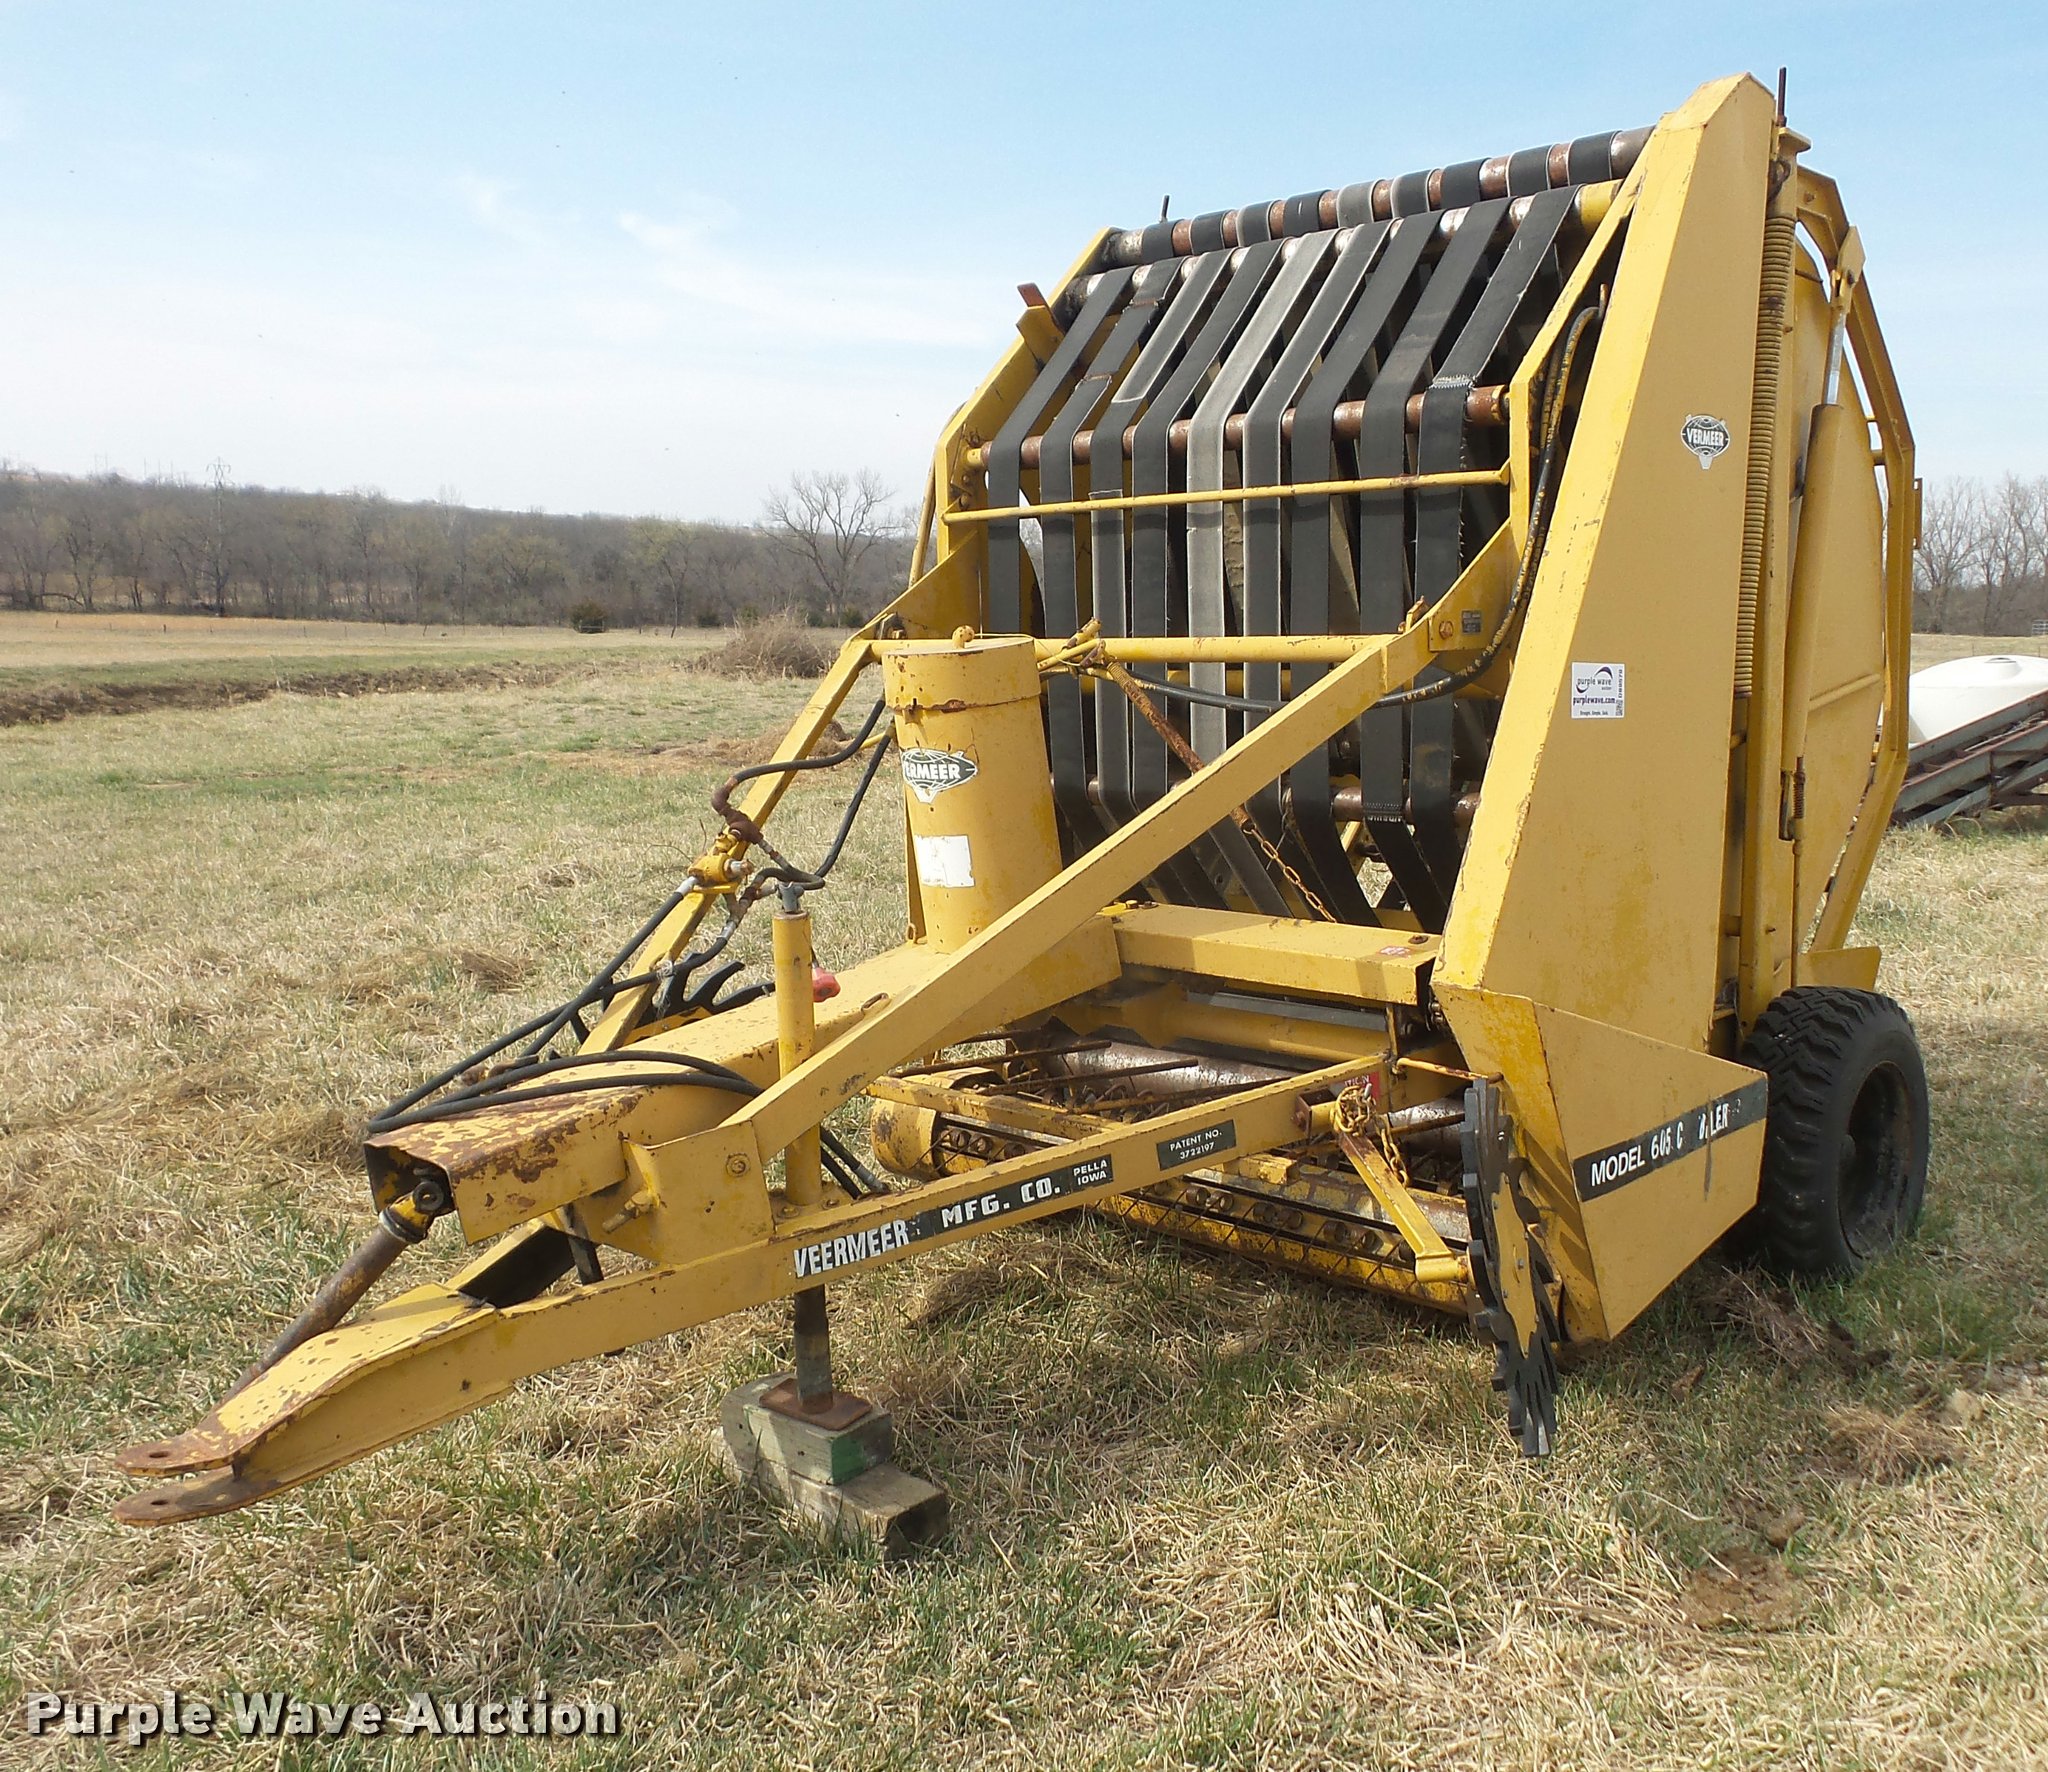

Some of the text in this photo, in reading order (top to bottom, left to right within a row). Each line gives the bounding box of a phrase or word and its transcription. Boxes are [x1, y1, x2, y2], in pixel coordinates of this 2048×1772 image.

[1686, 427, 1724, 447] VERMEER
[1577, 677, 1612, 686] purple wave
[1573, 695, 1616, 706] purplewave.com
[1170, 1129, 1222, 1152] PATENT NO.
[1180, 1142, 1215, 1160] 3722197
[1591, 1145, 1645, 1187] MODEL
[1650, 1126, 1672, 1161] 605
[1676, 1121, 1684, 1150] C
[1073, 1159, 1108, 1177] PELLA
[1077, 1170, 1107, 1186] IOWA
[793, 1177, 1061, 1278] VEERMEER MFG. CO.
